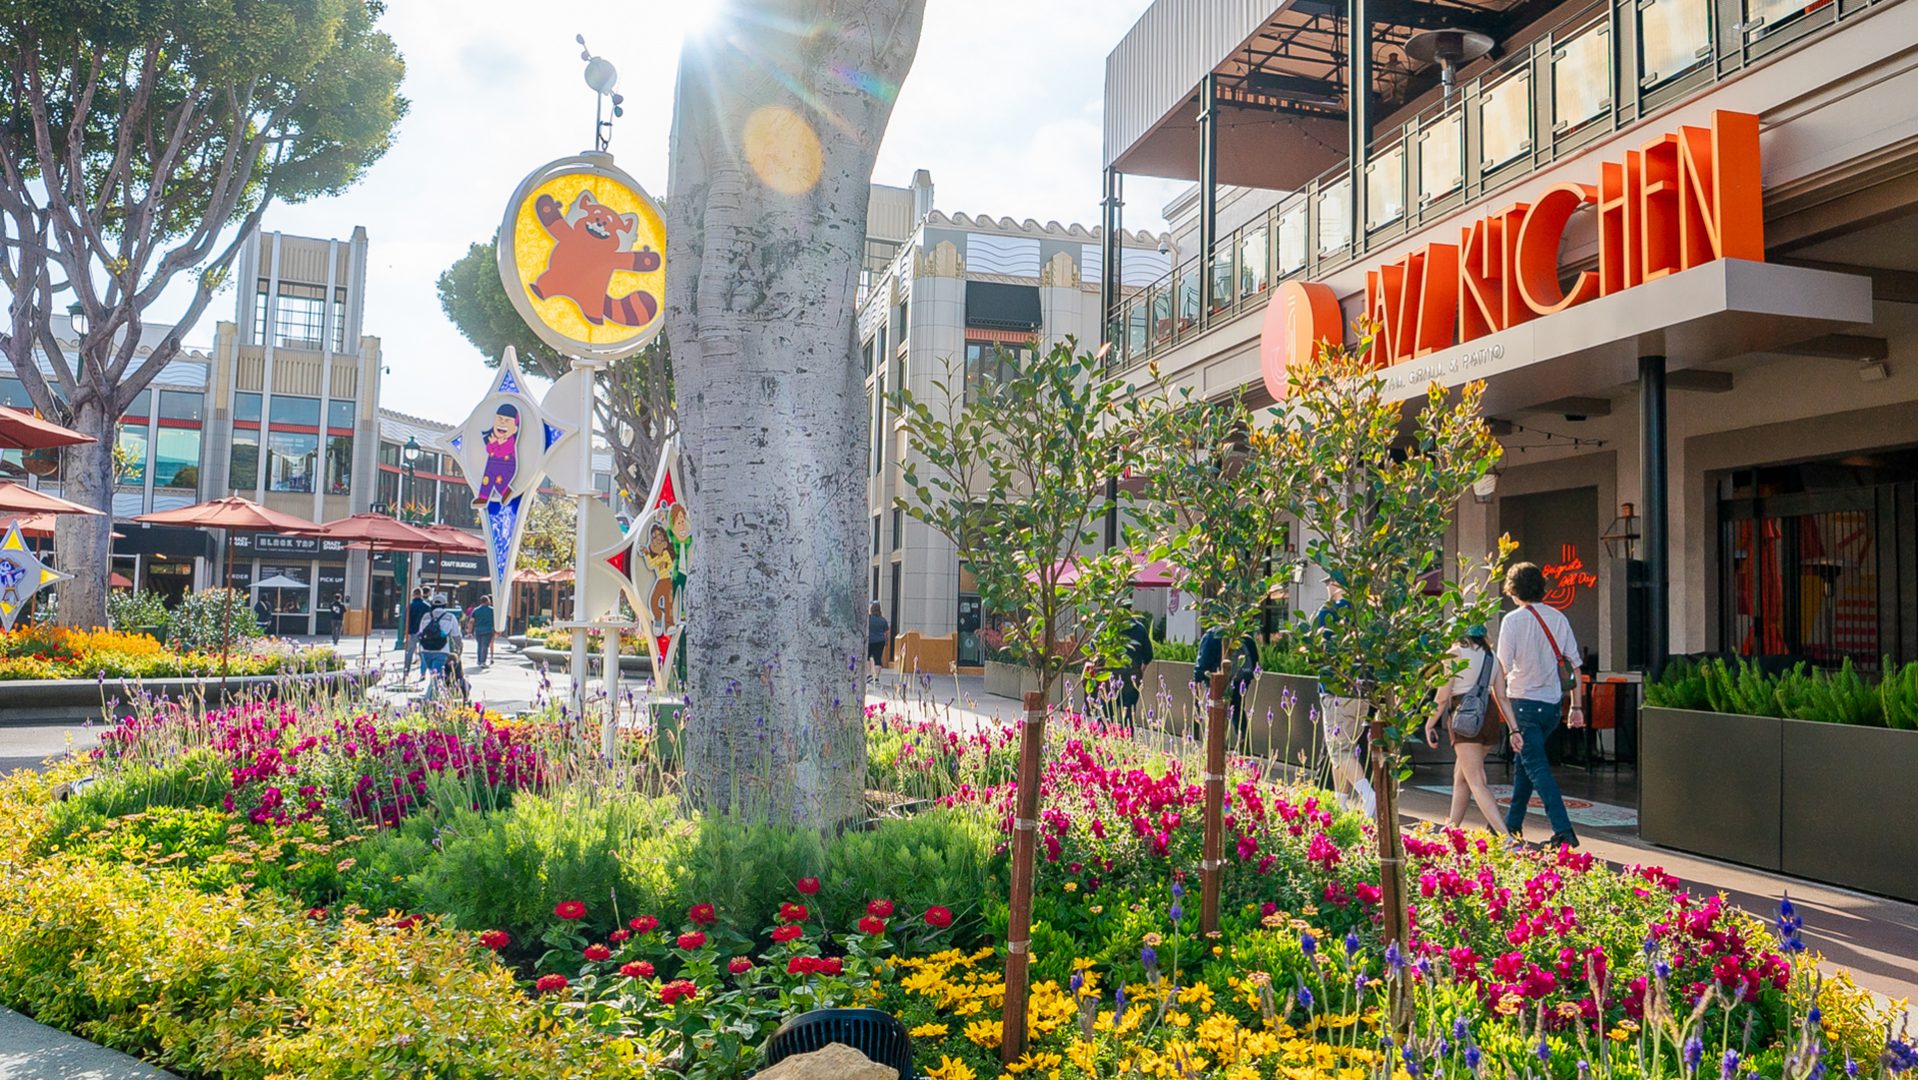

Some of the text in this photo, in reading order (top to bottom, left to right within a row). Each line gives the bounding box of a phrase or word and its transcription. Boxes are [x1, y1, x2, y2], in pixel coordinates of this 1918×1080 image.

[1459, 109, 1765, 344] KITCHEN
[1408, 362, 1446, 385] GRILL
[1462, 343, 1505, 369] PATIO
[260, 538, 315, 548] BLACK TAP
[455, 561, 478, 569] BURGERS
[1578, 571, 1597, 588] Day
